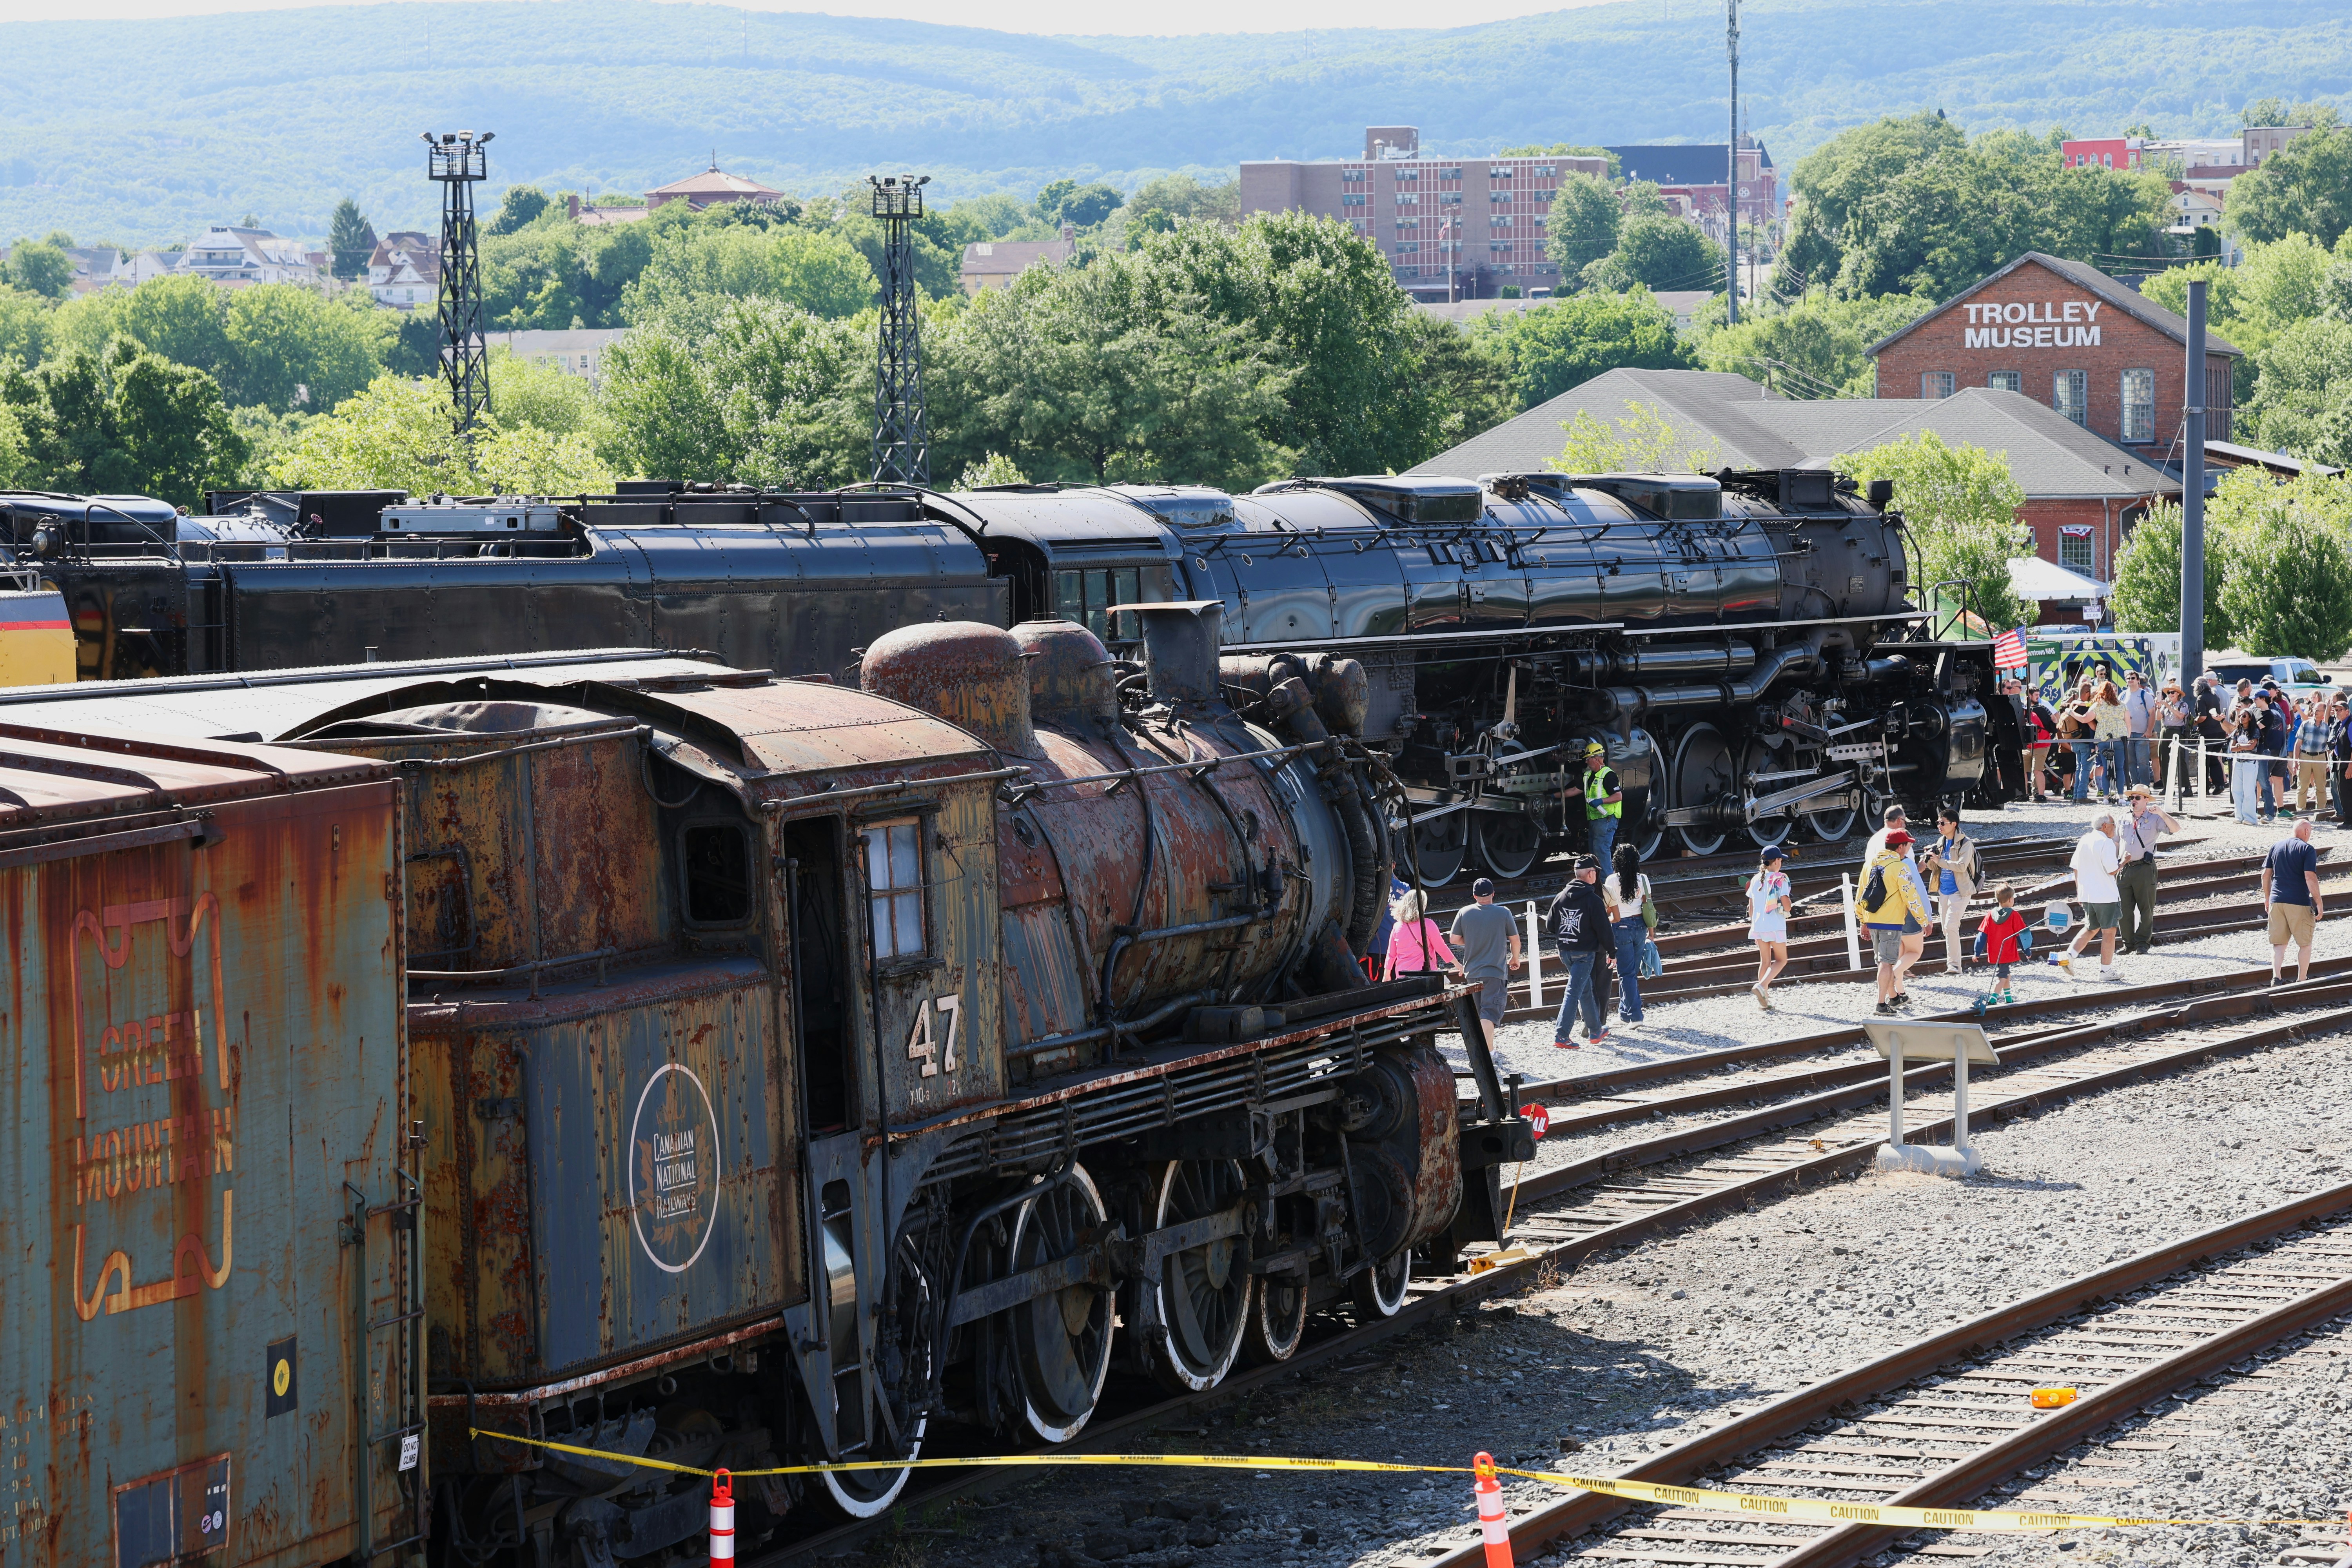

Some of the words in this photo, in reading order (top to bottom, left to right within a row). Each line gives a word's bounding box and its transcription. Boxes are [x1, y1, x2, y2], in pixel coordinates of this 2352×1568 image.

[1963, 301, 2102, 324] TROLLEY
[1965, 325, 2101, 348] MUSEUM
[908, 995, 959, 1077] 47
[100, 1009, 203, 1092] GREEN
[653, 1129, 694, 1161] CANADIAN
[76, 1107, 233, 1205] MOUNTAIN
[656, 1160, 696, 1192] NATIONAL
[657, 1190, 696, 1219] RAILWAYS
[404, 1443, 410, 1453] DO
[410, 1441, 419, 1451] NOT
[403, 1454, 416, 1465] CLIMB
[1573, 1477, 1616, 1491] CAUTION
[1654, 1488, 1699, 1503] CAUTION
[1740, 1497, 1787, 1513] CAUTION
[1830, 1506, 1879, 1521] CAUTION
[1923, 1512, 1974, 1525] CAUTION
[2020, 1515, 2070, 1526] CAUTION
